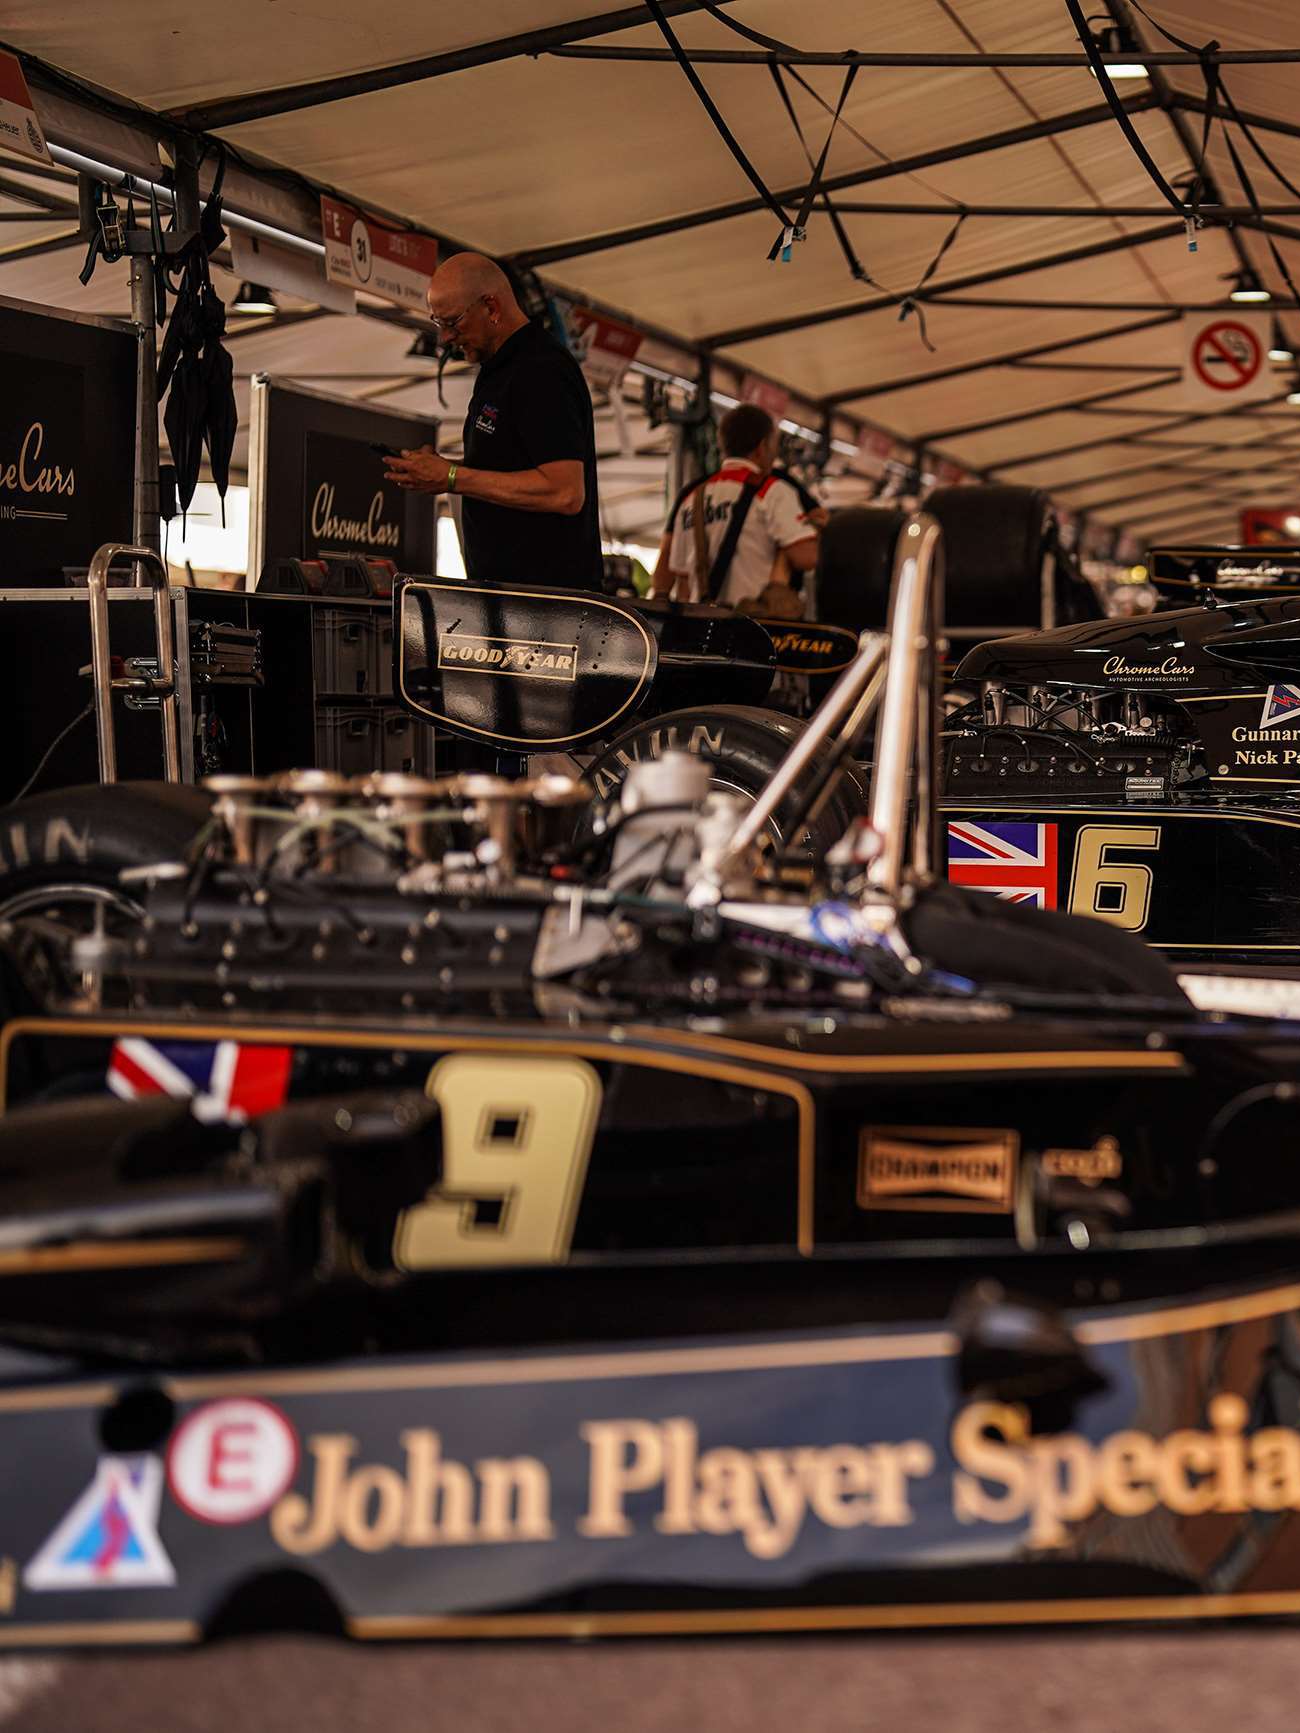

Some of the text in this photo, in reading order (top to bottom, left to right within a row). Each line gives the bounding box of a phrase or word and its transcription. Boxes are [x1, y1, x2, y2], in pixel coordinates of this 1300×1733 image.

[311, 481, 400, 547] ChromeCars
[442, 644, 573, 670] GOODYEAR
[1103, 655, 1195, 675] ChromeCars
[1231, 726, 1300, 742] Gunnar
[1234, 750, 1279, 765] Nick
[1066, 823, 1163, 934] 6
[396, 1053, 602, 1271] 9
[208, 1421, 260, 1492] E
[270, 1428, 555, 1555] John
[577, 1417, 935, 1559] Player
